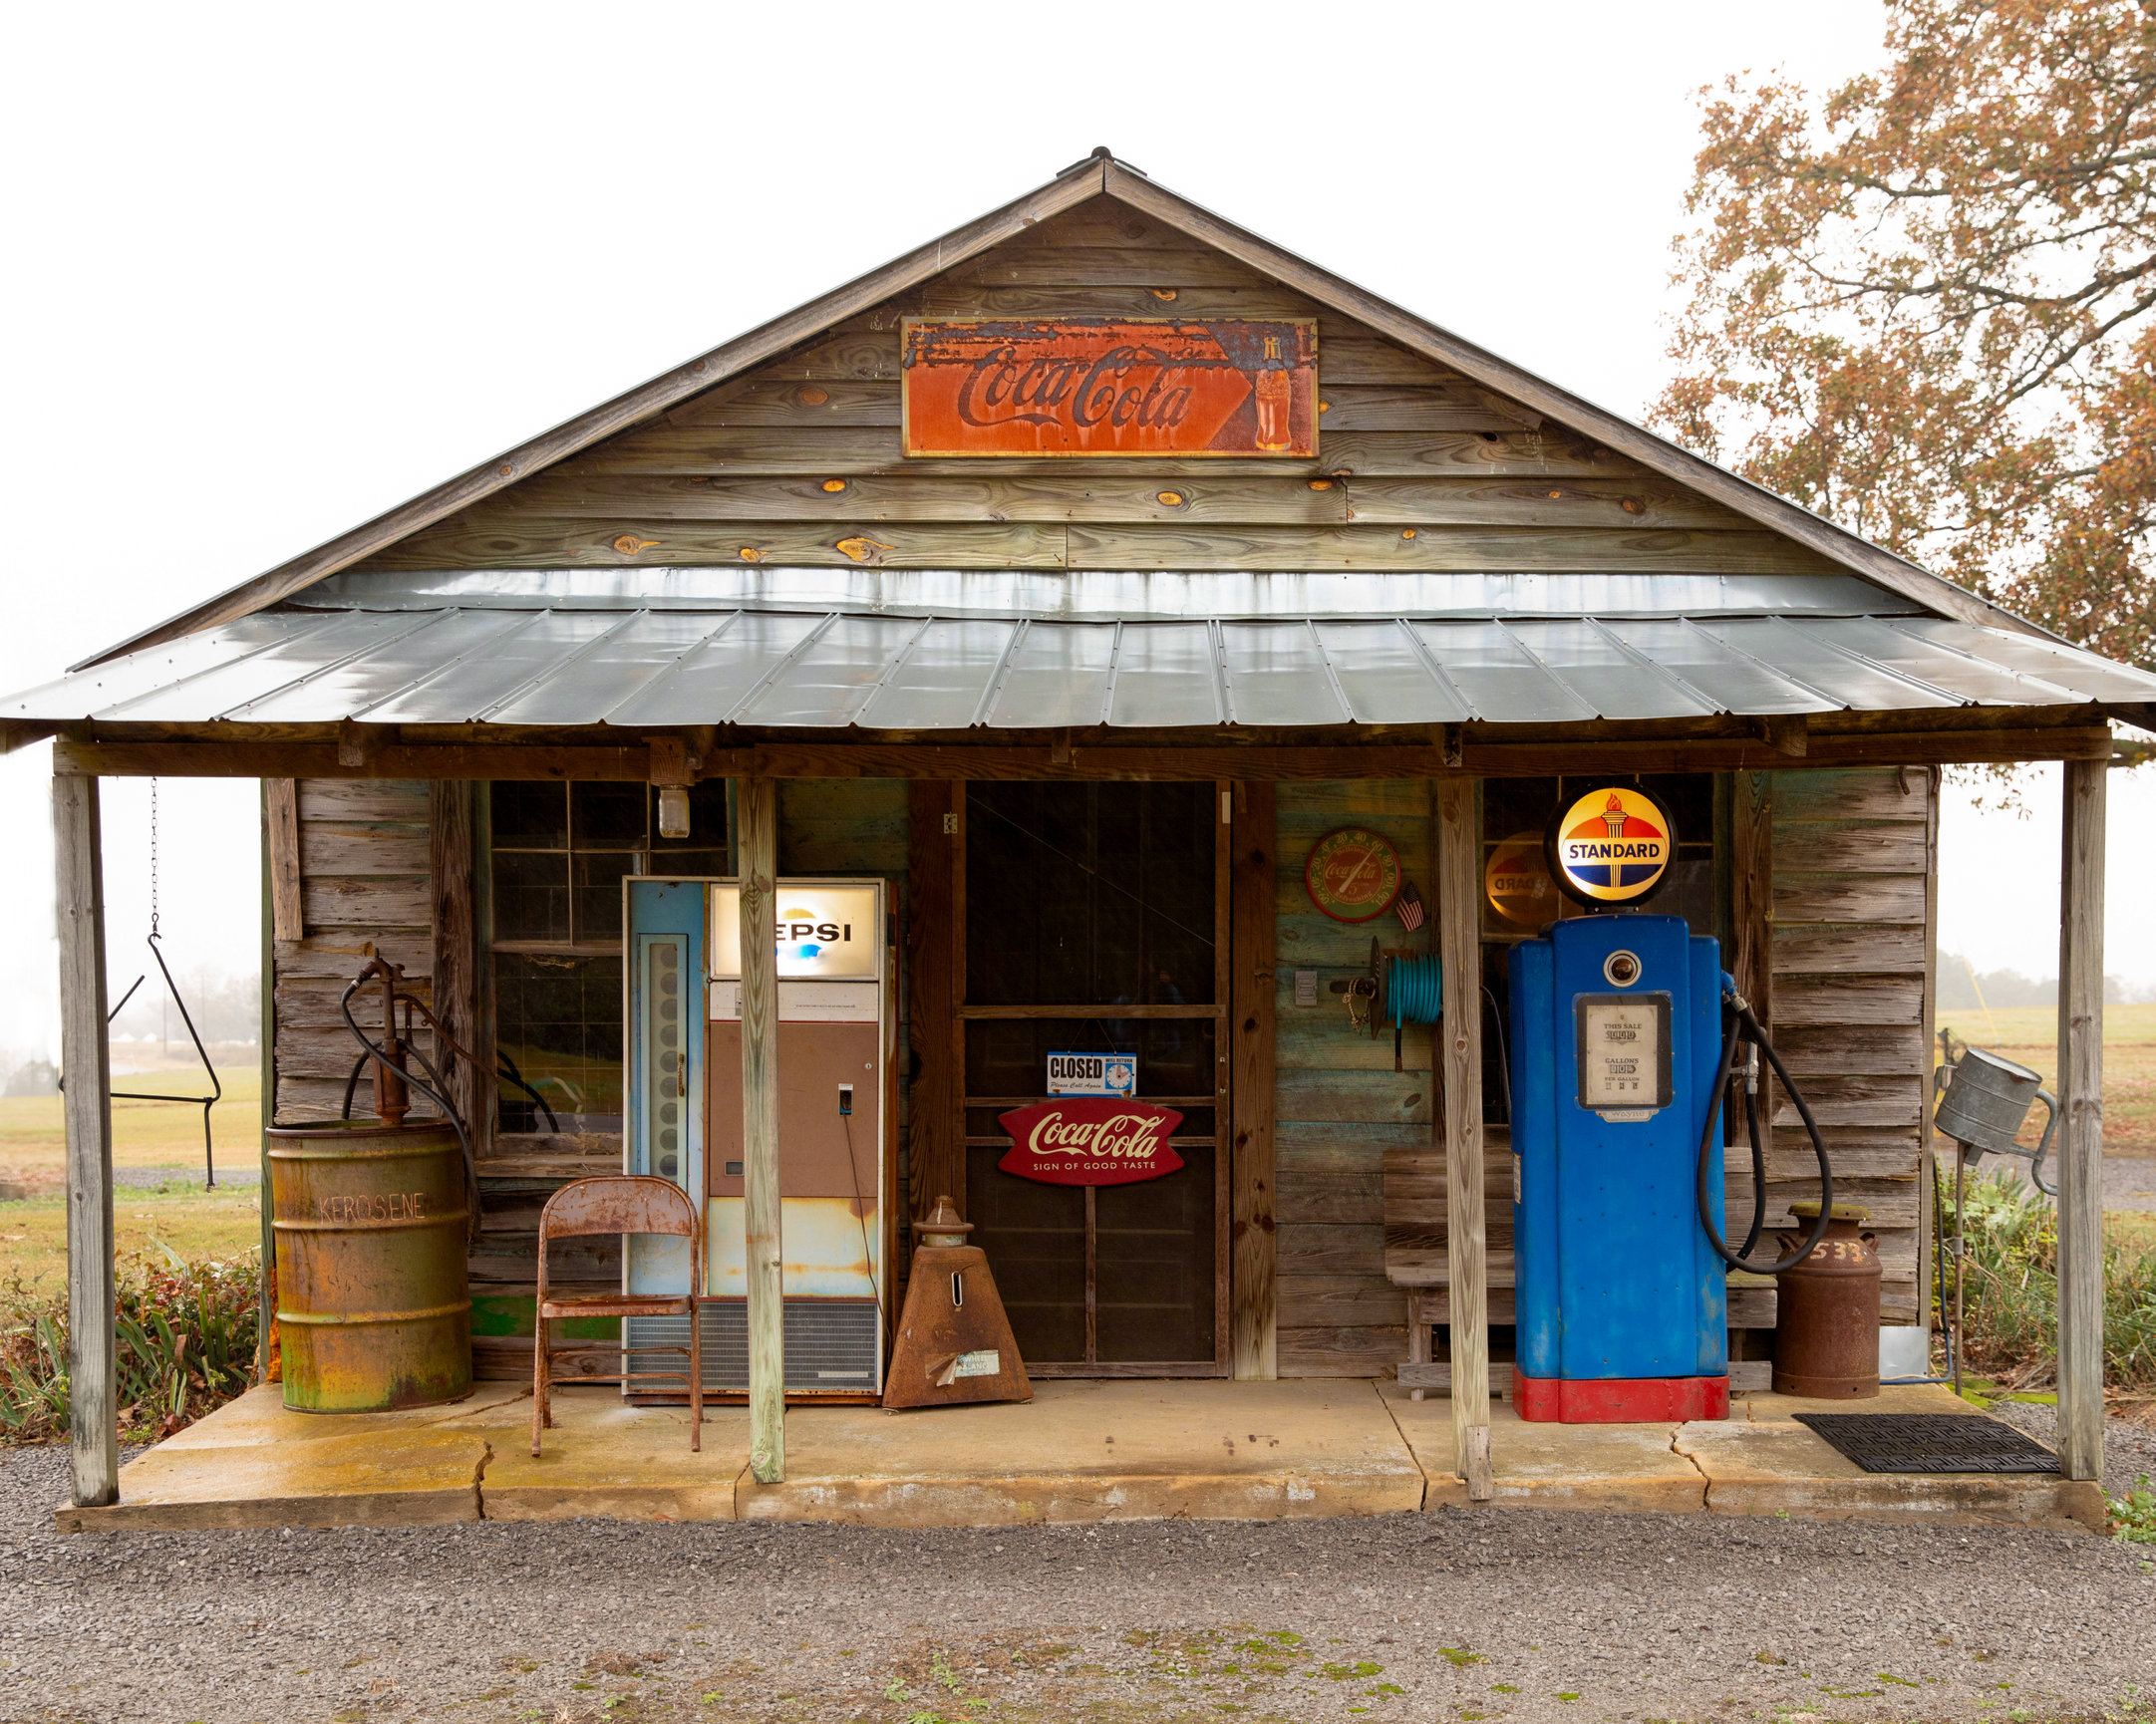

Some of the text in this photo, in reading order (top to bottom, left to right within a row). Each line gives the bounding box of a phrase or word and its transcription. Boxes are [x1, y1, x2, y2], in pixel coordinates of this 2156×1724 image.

[958, 345, 1195, 428] Coca-Cola
[1354, 832, 1367, 842] 40
[1569, 843, 1661, 859] STANDARD
[775, 923, 851, 942] EPSI
[1050, 1057, 1102, 1078] CLOSED
[1029, 1111, 1166, 1158] Coca-Cola
[319, 1193, 426, 1225] KEROSENE
